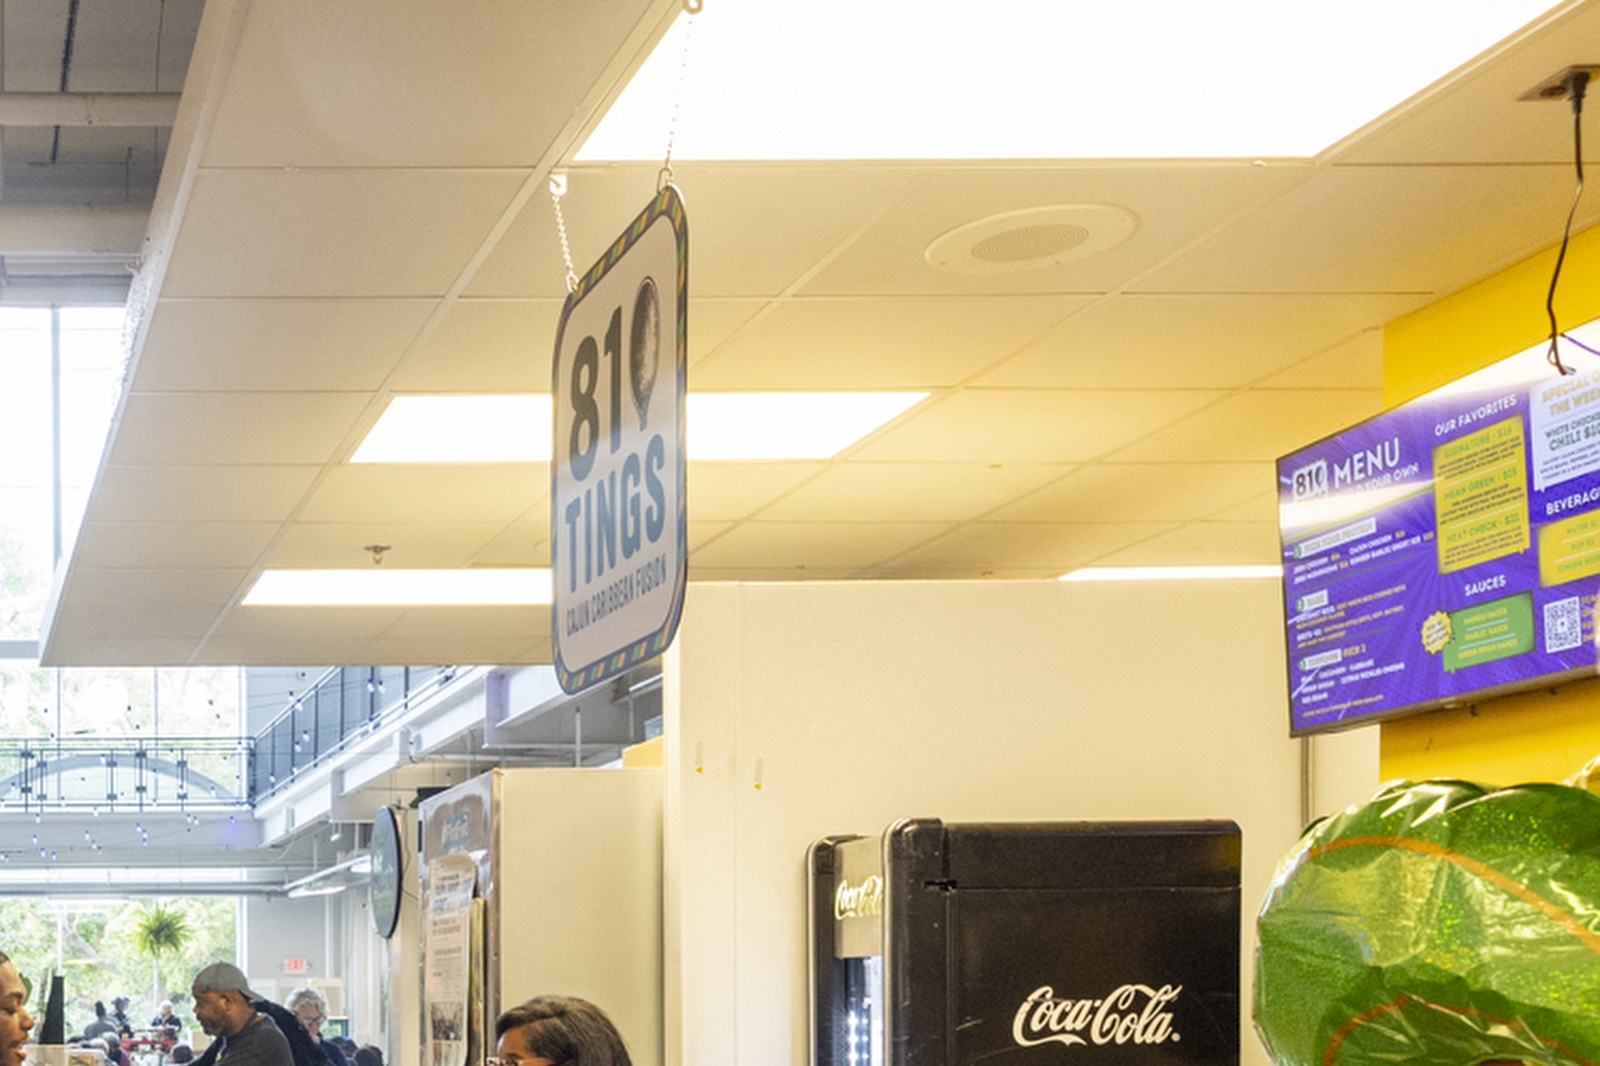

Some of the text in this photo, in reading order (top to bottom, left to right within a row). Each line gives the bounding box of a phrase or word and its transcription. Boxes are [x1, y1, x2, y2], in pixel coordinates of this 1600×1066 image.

[1434, 394, 1517, 436] OUR FAVORITES
[1333, 437, 1399, 489] MENU
[565, 434, 664, 593] TINGS
[1546, 486, 1600, 515] BEVERAG
[636, 552, 666, 598] FUSION
[1464, 574, 1507, 597] SAUCES
[1012, 985, 1182, 1047] Coca-Cola
